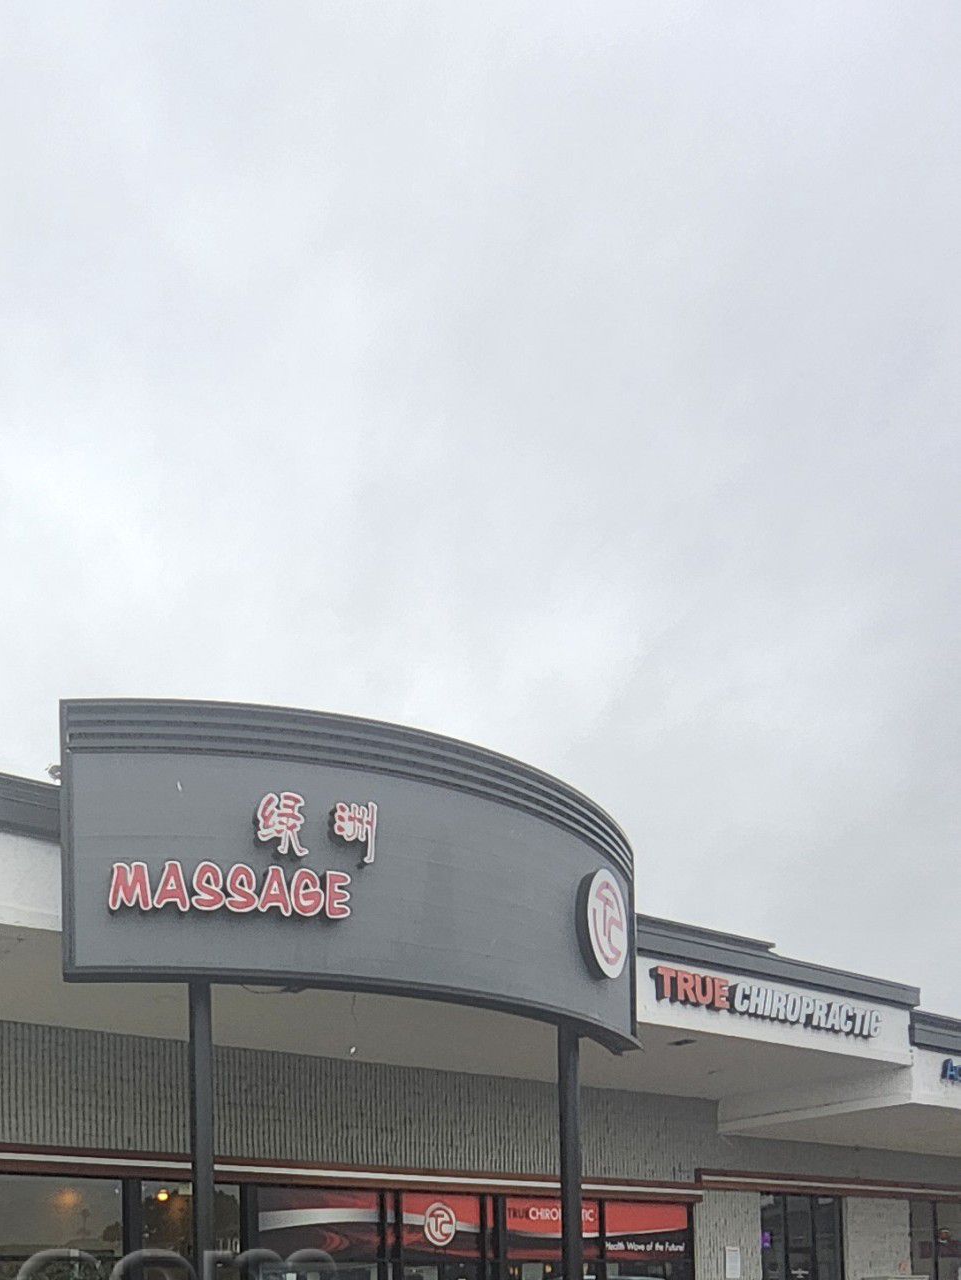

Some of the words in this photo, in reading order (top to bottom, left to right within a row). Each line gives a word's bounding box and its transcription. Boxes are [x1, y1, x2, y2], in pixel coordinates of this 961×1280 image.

[108, 860, 352, 919] MASSAGE
[656, 966, 730, 1010] TRUE
[734, 982, 883, 1038] CHIROPRACTIC
[605, 1240, 626, 1251] Health
[626, 1241, 646, 1252] Wave
